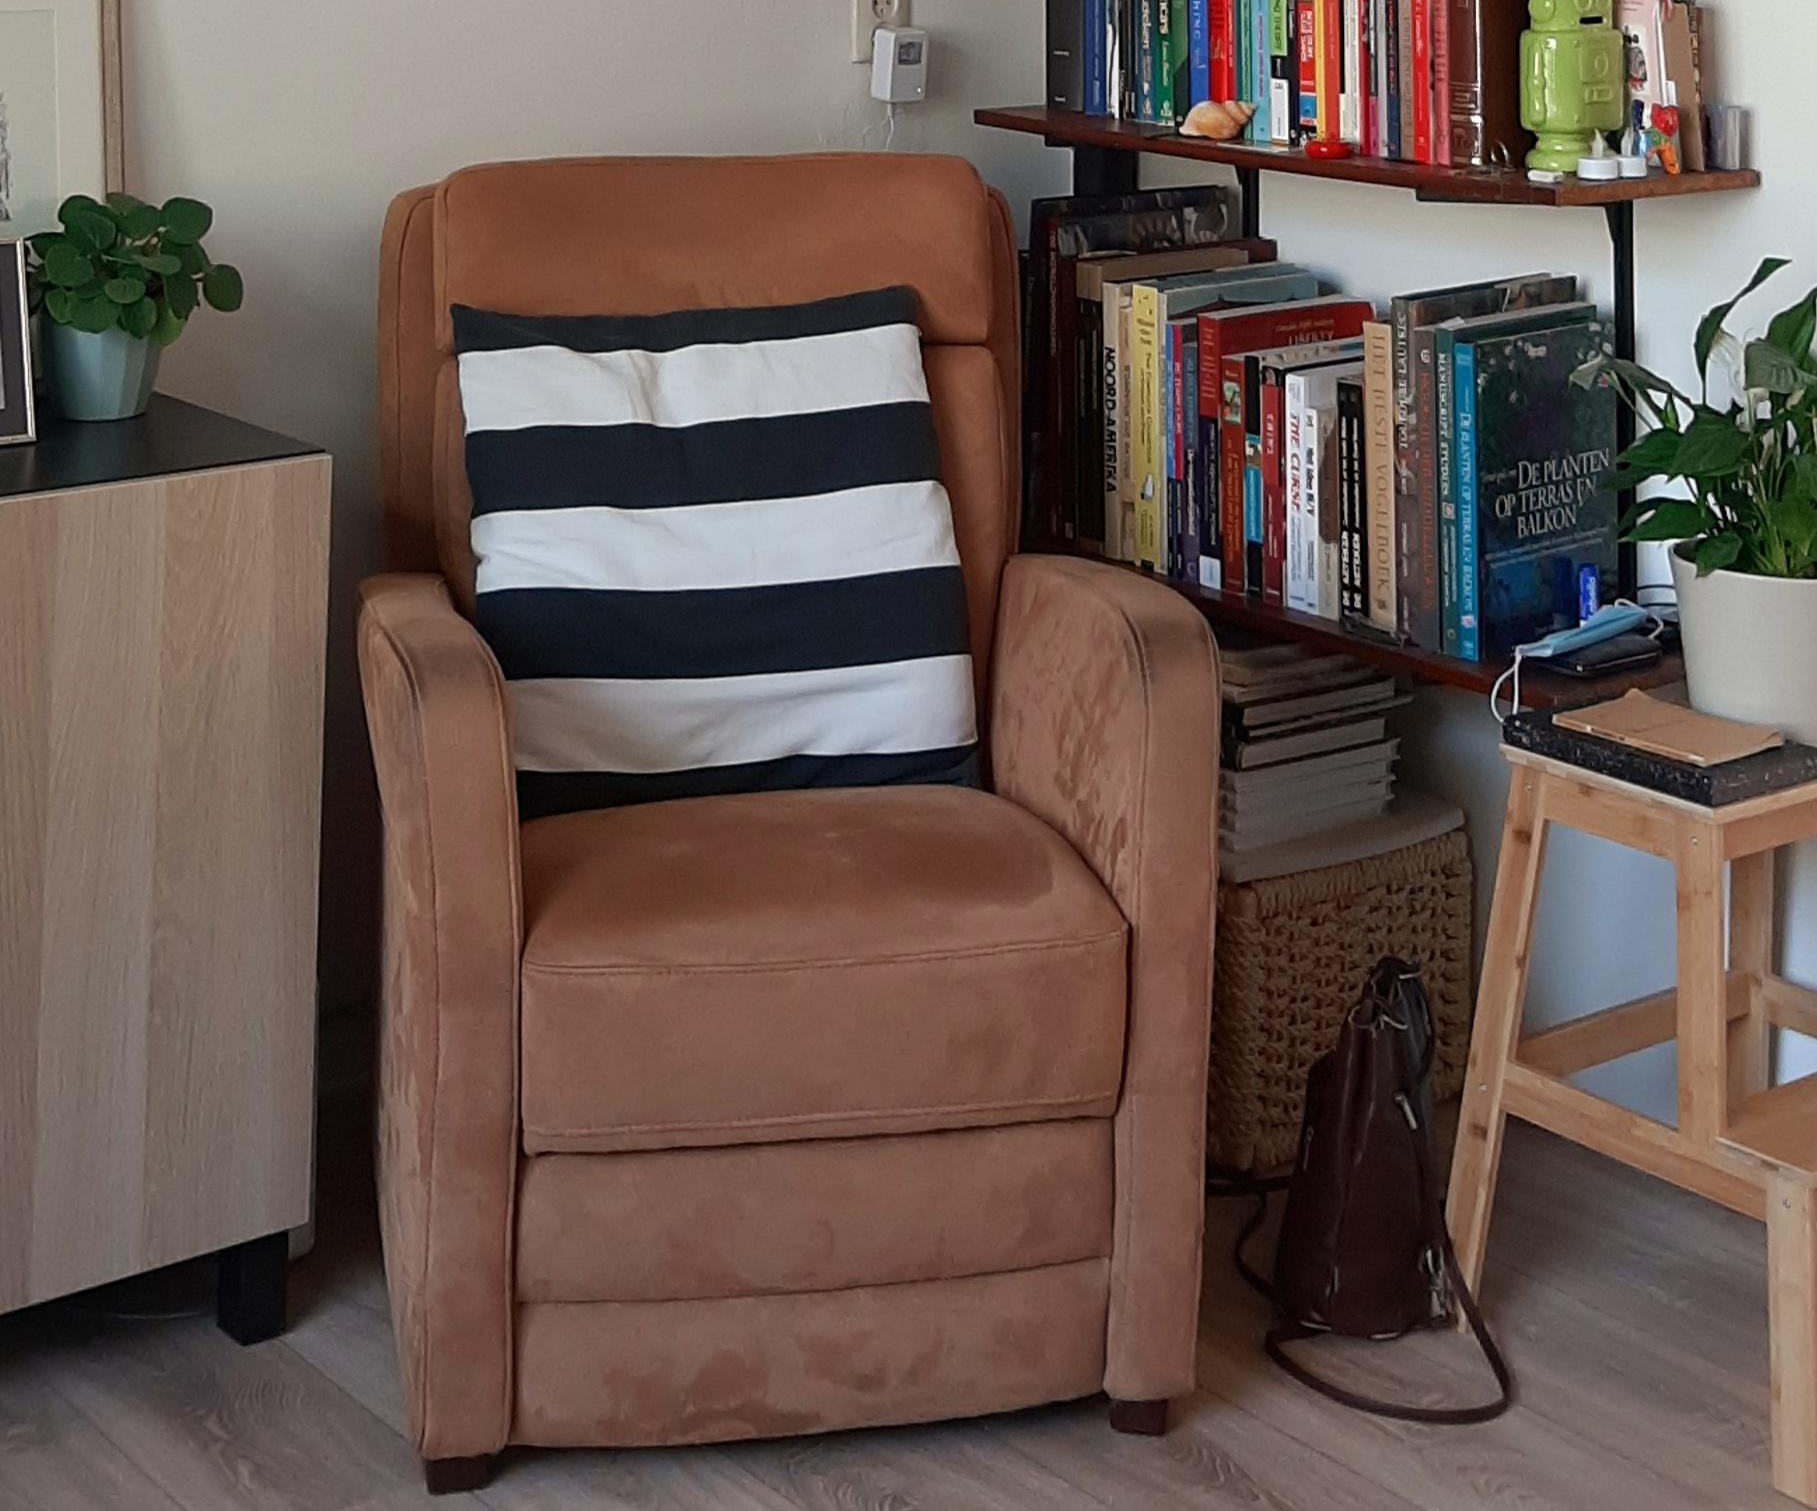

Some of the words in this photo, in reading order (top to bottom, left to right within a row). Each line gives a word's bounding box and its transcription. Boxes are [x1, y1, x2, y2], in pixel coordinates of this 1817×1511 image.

[1372, 334, 1387, 376] HET
[1103, 345, 1118, 493] NOORD-AMERIKA
[1372, 388, 1388, 450] BESTE
[1437, 352, 1449, 438] MANUSCRIPT
[1290, 413, 1301, 449] THE
[1290, 452, 1301, 514] CURSE
[1517, 460, 1542, 489] DE
[1543, 448, 1610, 482] PLANTEN
[1494, 493, 1517, 519] OP
[1518, 479, 1574, 514] TERRAS
[1516, 504, 1577, 540] BALKON
[1375, 463, 1390, 591] VOGELBOEK
